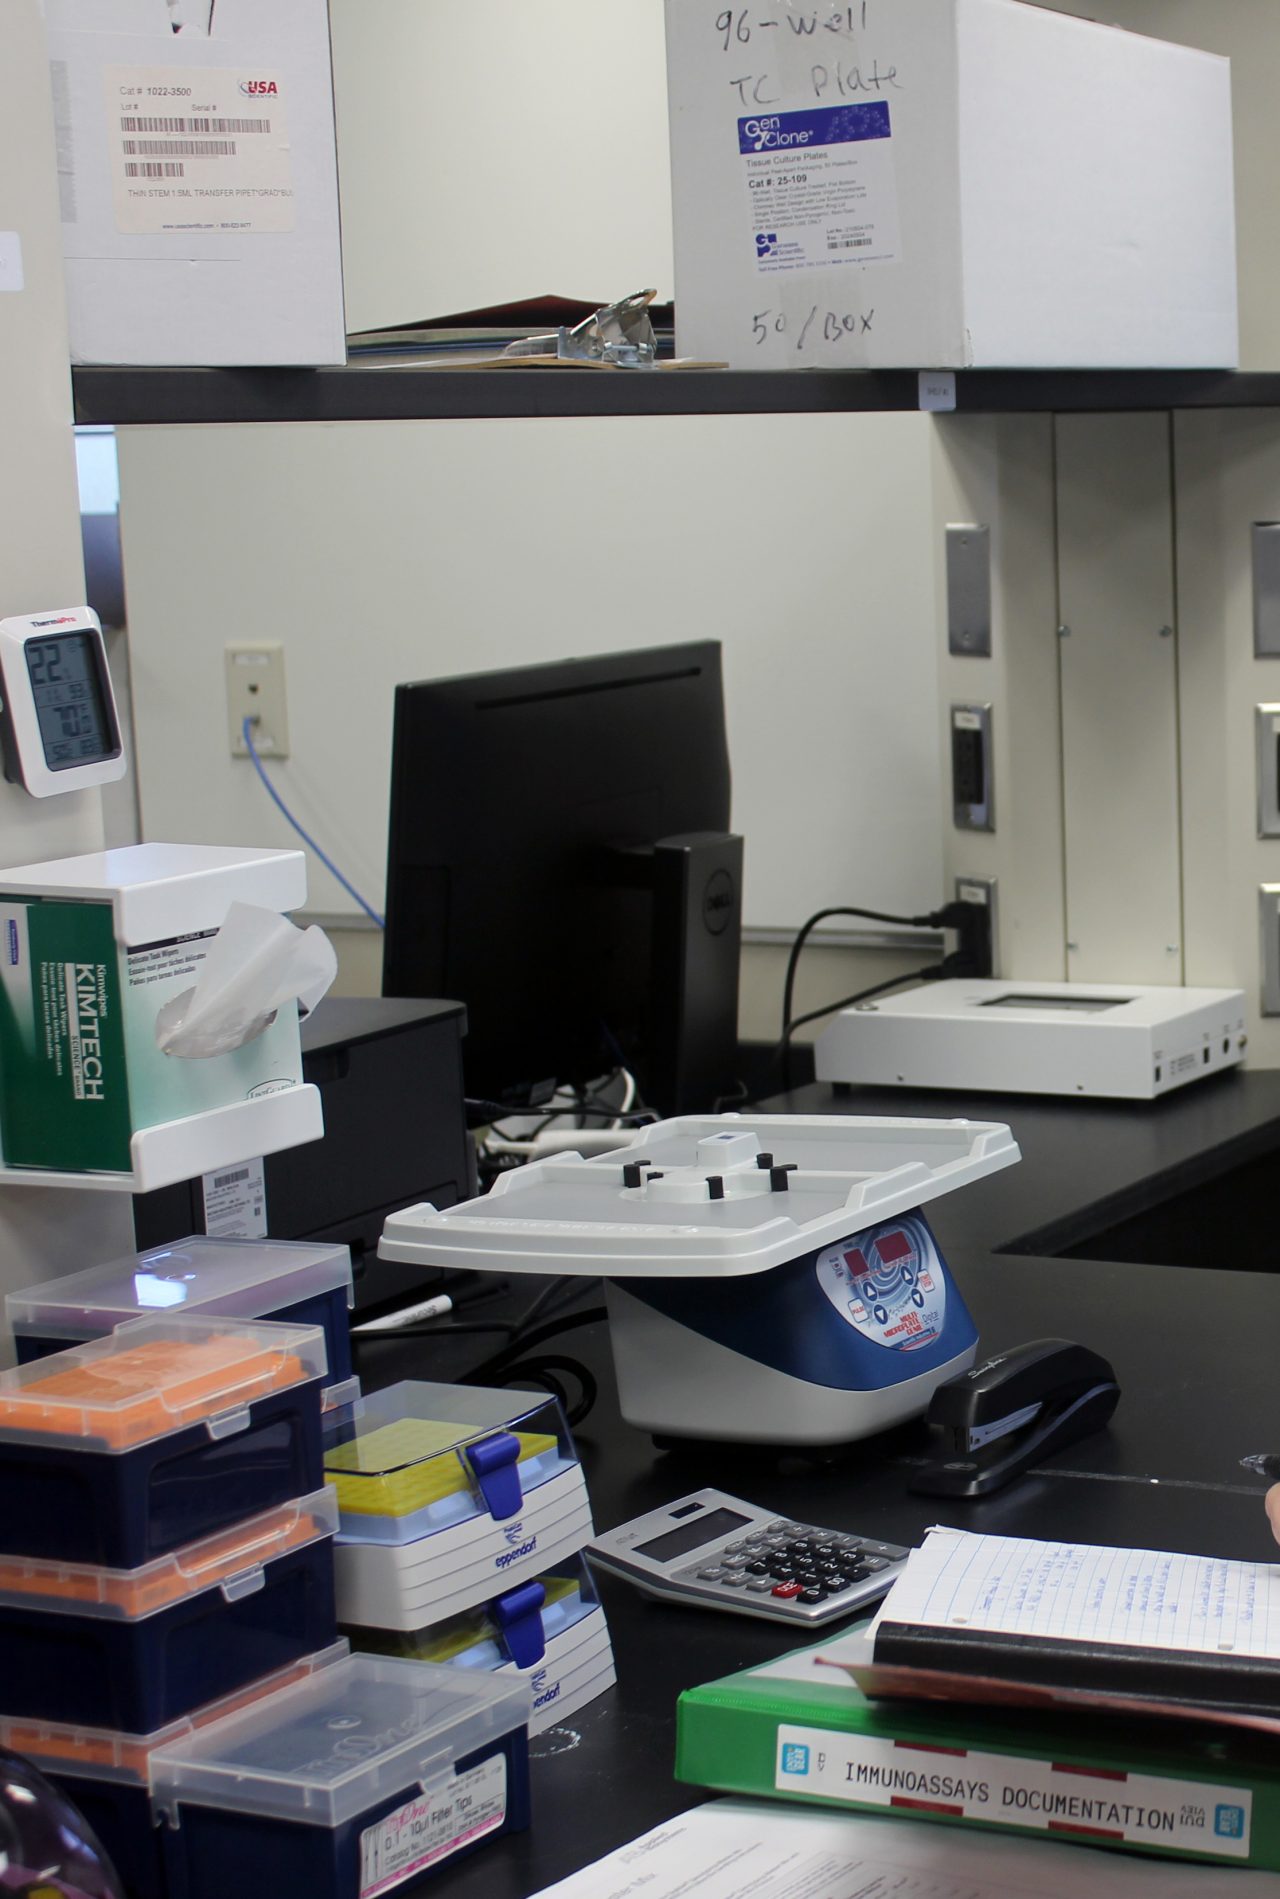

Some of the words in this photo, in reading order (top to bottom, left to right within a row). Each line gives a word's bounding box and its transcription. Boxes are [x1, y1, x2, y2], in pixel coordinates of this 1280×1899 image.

[119, 86, 136, 96] Cat
[147, 87, 192, 97] 1022-3500
[248, 81, 278, 94] USA
[730, 75, 780, 106] TC
[811, 60, 904, 97] Plate
[120, 103, 132, 111] Lot
[191, 104, 211, 112] Serial
[745, 116, 780, 137] Gen
[763, 130, 810, 148] Clone
[746, 158, 772, 168] Tissue
[773, 154, 802, 166] Culture
[803, 151, 829, 162] Plates
[748, 179, 765, 189] Cat
[777, 174, 808, 186] 25-109
[128, 189, 147, 198] THIN
[148, 189, 170, 198] STEM
[194, 189, 234, 198] TRANSFER
[127, 954, 149, 965] Delicate
[162, 949, 179, 959] Wipers
[57, 962, 65, 992] Delicate
[96, 964, 107, 1018] Kimwipes
[75, 963, 105, 1100] KIMTECH
[71, 1035, 81, 1070] SCIENCE
[495, 1536, 537, 1568] eppendorf
[845, 1761, 990, 1803] IMMUNOASSAYS
[1002, 1785, 1176, 1832] DOCUMENTATION
[431, 1804, 454, 1825] Filter
[455, 1794, 473, 1811] Tips
